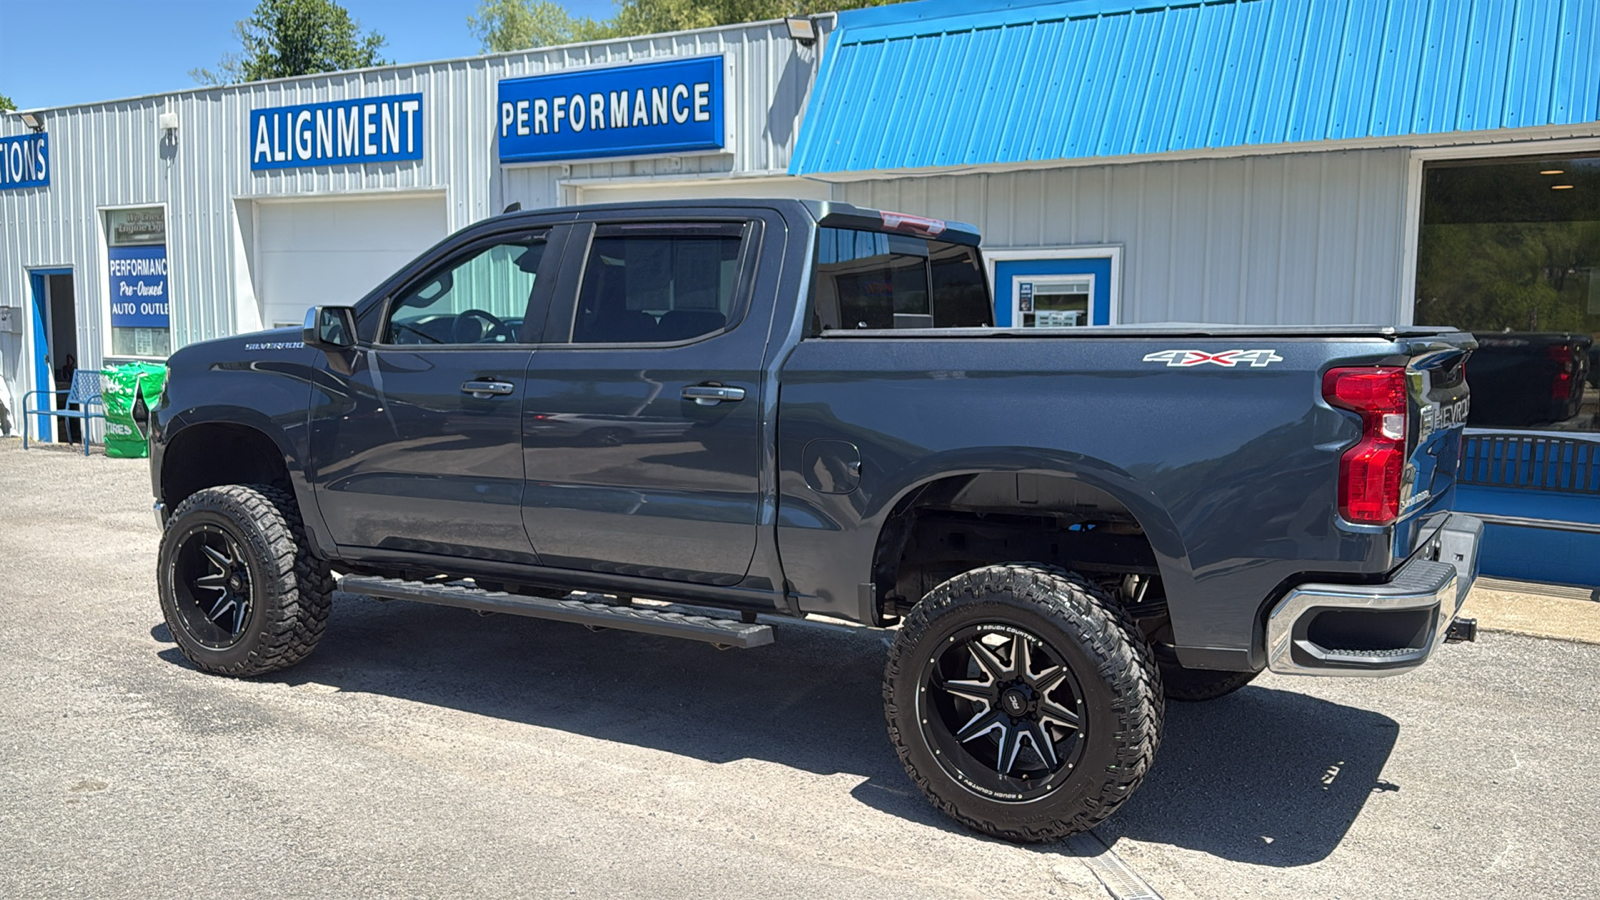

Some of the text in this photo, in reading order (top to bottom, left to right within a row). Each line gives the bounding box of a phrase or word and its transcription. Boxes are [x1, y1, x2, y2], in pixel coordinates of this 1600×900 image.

[501, 82, 711, 138] PERFORMANCE
[253, 100, 420, 164] ALIGNMENT
[120, 280, 164, 297] Pre-Owned
[112, 302, 137, 315] AUTO
[245, 341, 305, 350] SILVERADO
[1006, 626, 1037, 642] COUNTRY
